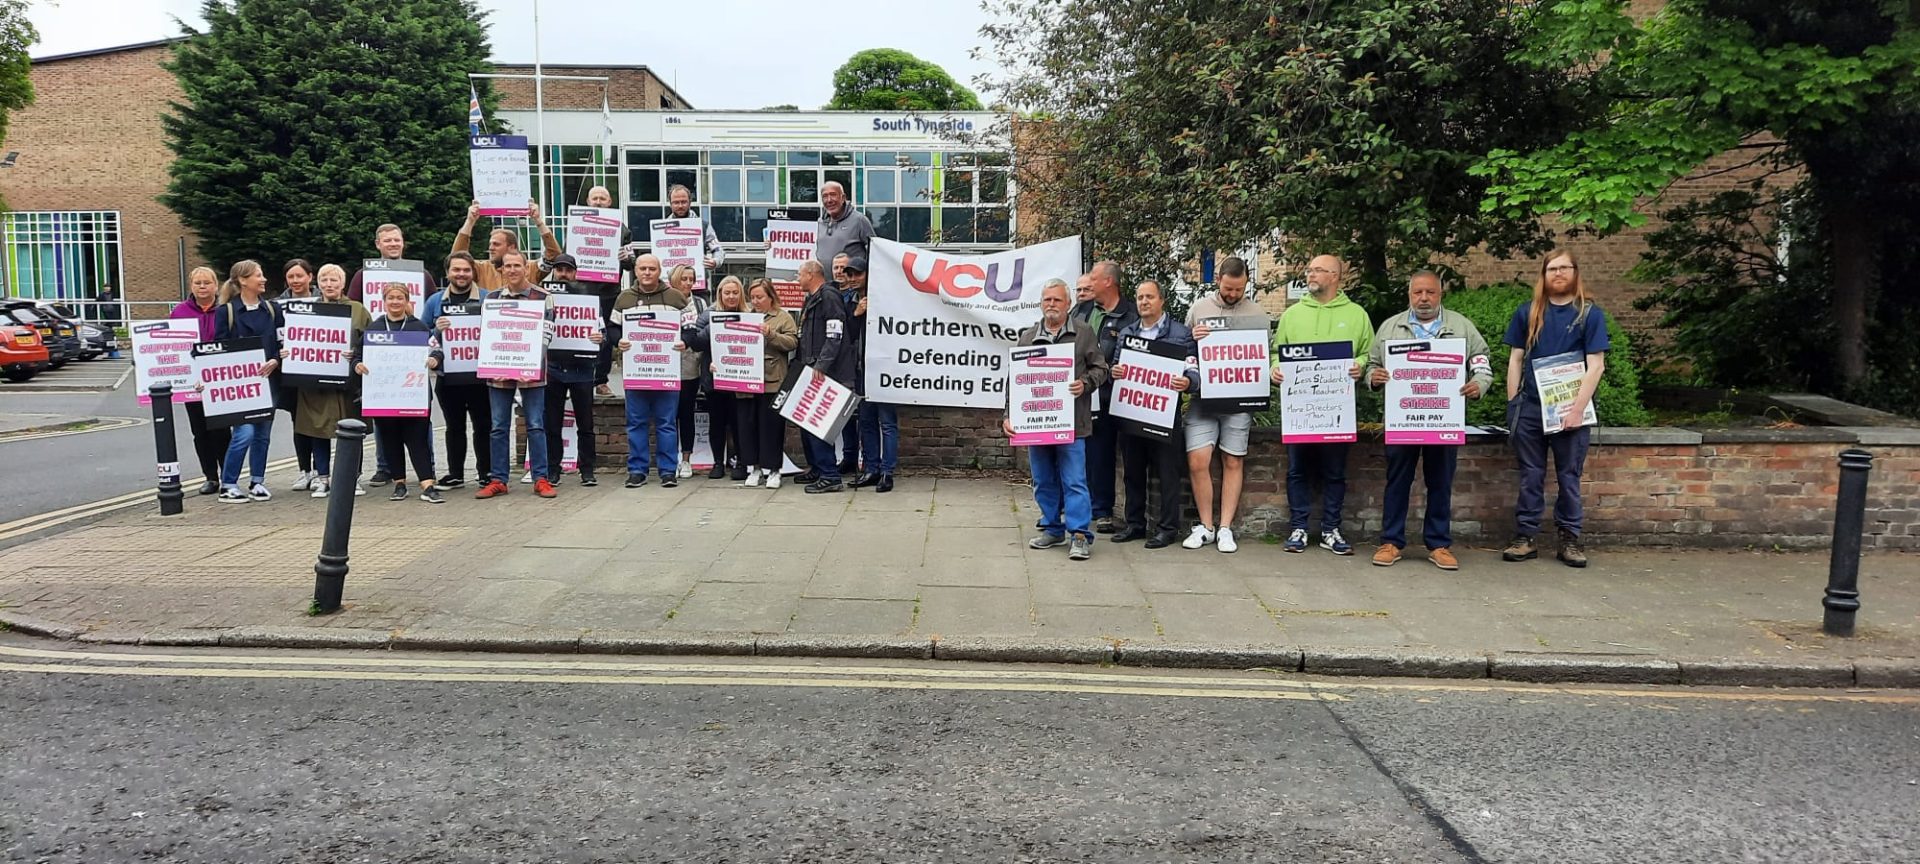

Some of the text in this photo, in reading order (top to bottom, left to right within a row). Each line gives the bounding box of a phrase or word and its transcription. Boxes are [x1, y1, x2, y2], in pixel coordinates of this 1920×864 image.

[873, 118, 972, 134] South Tyneside
[472, 137, 496, 146] UCU
[770, 230, 815, 244] OFFICIAL
[773, 248, 811, 260] PICKET
[902, 252, 1024, 303] UCU
[288, 303, 312, 312] UCU
[554, 306, 596, 320] FFICIAL
[878, 316, 984, 338] Northern
[288, 326, 347, 344] OFFICIAL
[367, 334, 394, 342] UCU
[445, 327, 480, 342] OFFIC
[196, 342, 222, 352] UCU
[1126, 337, 1148, 350] UCU
[291, 347, 342, 364] PICKET
[899, 348, 1002, 370] Defending
[1202, 344, 1266, 361] OFFICIAL
[1282, 346, 1312, 358] UCU
[1208, 366, 1261, 384] PICKET
[1296, 365, 1312, 374] Less
[1393, 368, 1458, 380] SUPPORT
[880, 374, 1009, 394] Defending Ed
[1016, 370, 1069, 385] SUPPORT
[1120, 364, 1177, 390] OFFICIA
[1294, 377, 1312, 385] Less
[210, 383, 261, 402] PICKET
[1288, 387, 1308, 396] Less
[1411, 383, 1438, 394] THE
[1118, 387, 1169, 412] PICKET
[1400, 397, 1450, 409] STRIKE
[808, 386, 838, 428] PICKET
[1288, 404, 1342, 412] More Directors
